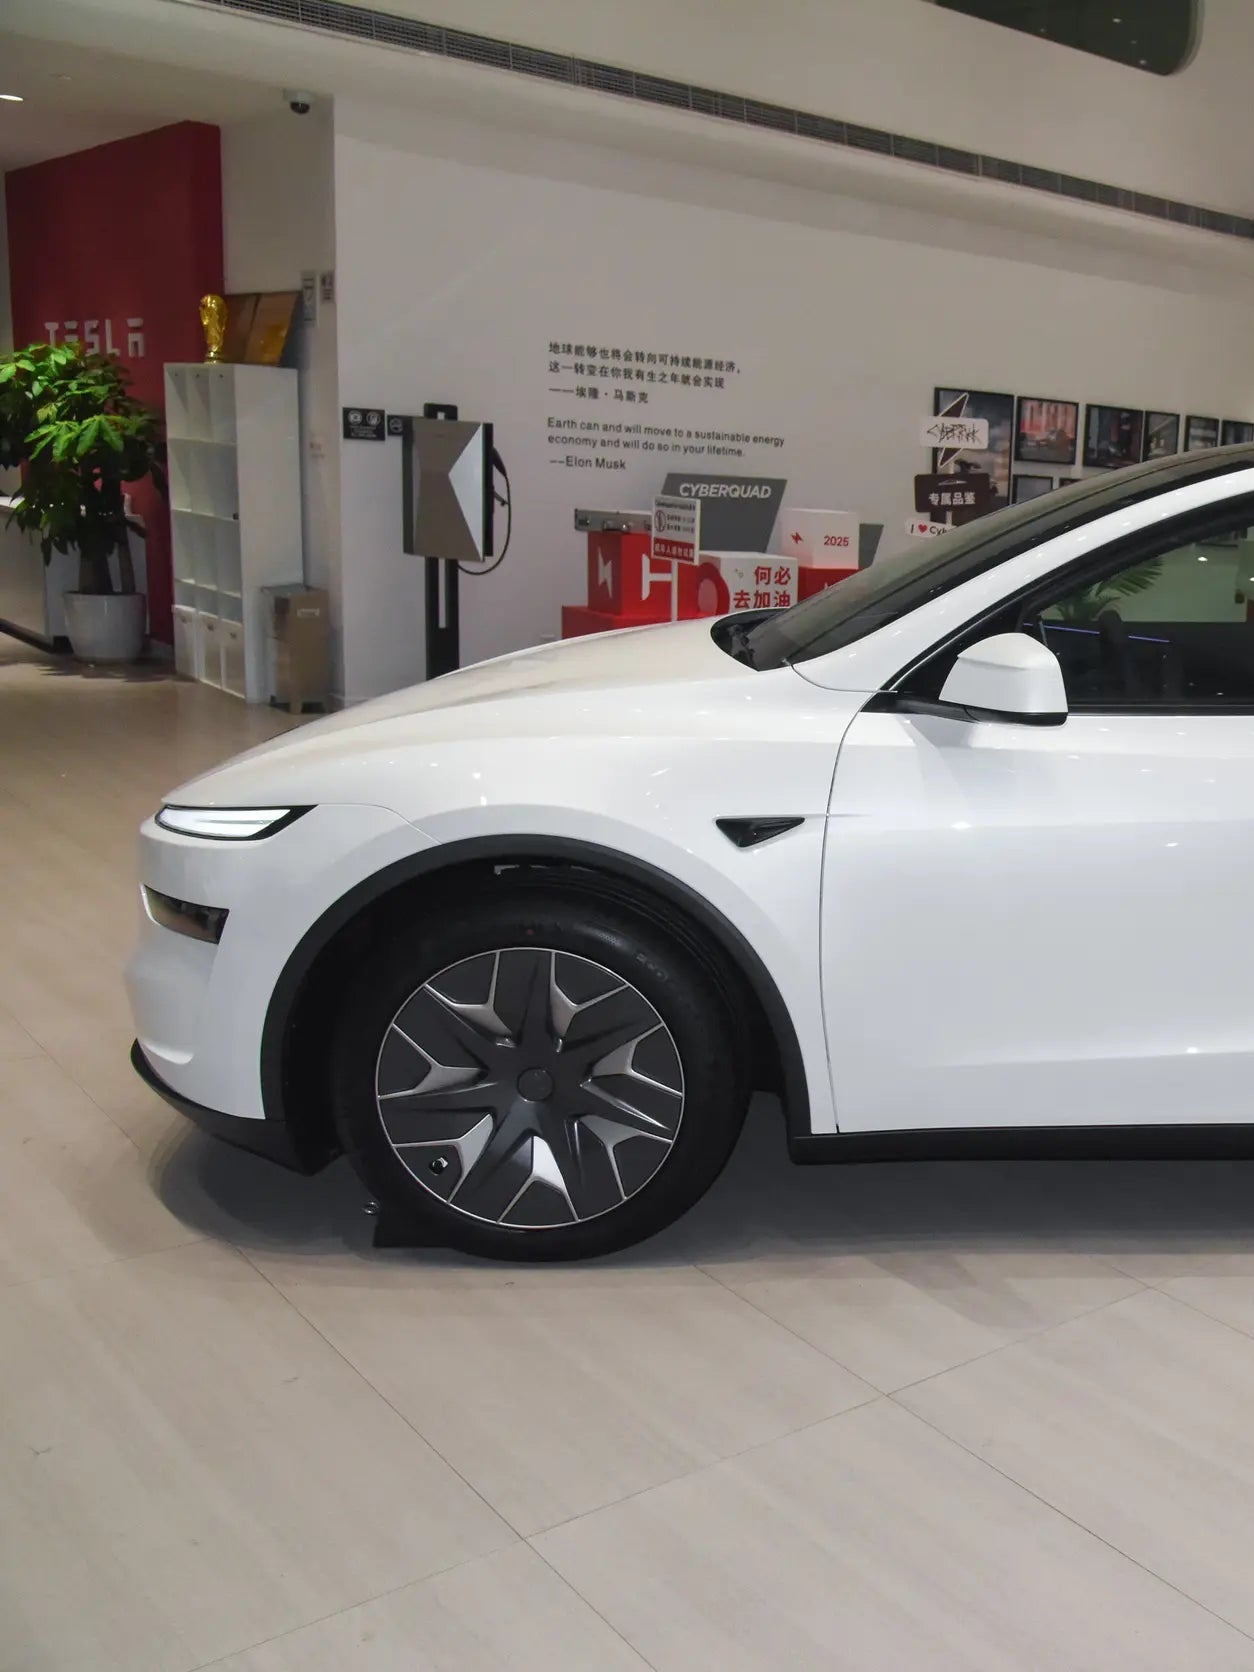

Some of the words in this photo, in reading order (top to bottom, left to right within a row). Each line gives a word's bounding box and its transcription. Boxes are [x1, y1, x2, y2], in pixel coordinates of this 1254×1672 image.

[44, 318, 145, 357] TESLA
[547, 417, 577, 429] Earth
[580, 421, 600, 431] can
[602, 423, 622, 433] and
[624, 424, 642, 435] will
[643, 427, 672, 437] move
[674, 428, 684, 438] to
[686, 430, 692, 438] a
[694, 431, 751, 443] sustainable
[752, 436, 784, 448] energy
[547, 435, 597, 449] economy
[600, 438, 620, 448] and
[622, 439, 640, 449] will
[642, 441, 655, 451] do
[657, 443, 670, 452] so
[671, 443, 681, 453] in
[683, 443, 705, 455] your
[595, 457, 627, 470] Musk
[679, 482, 772, 499] CYBERQUAD
[928, 491, 976, 506] 专属品鉴
[823, 535, 850, 547] 2025
[754, 565, 791, 586] 何必
[733, 590, 791, 609] 去加油
